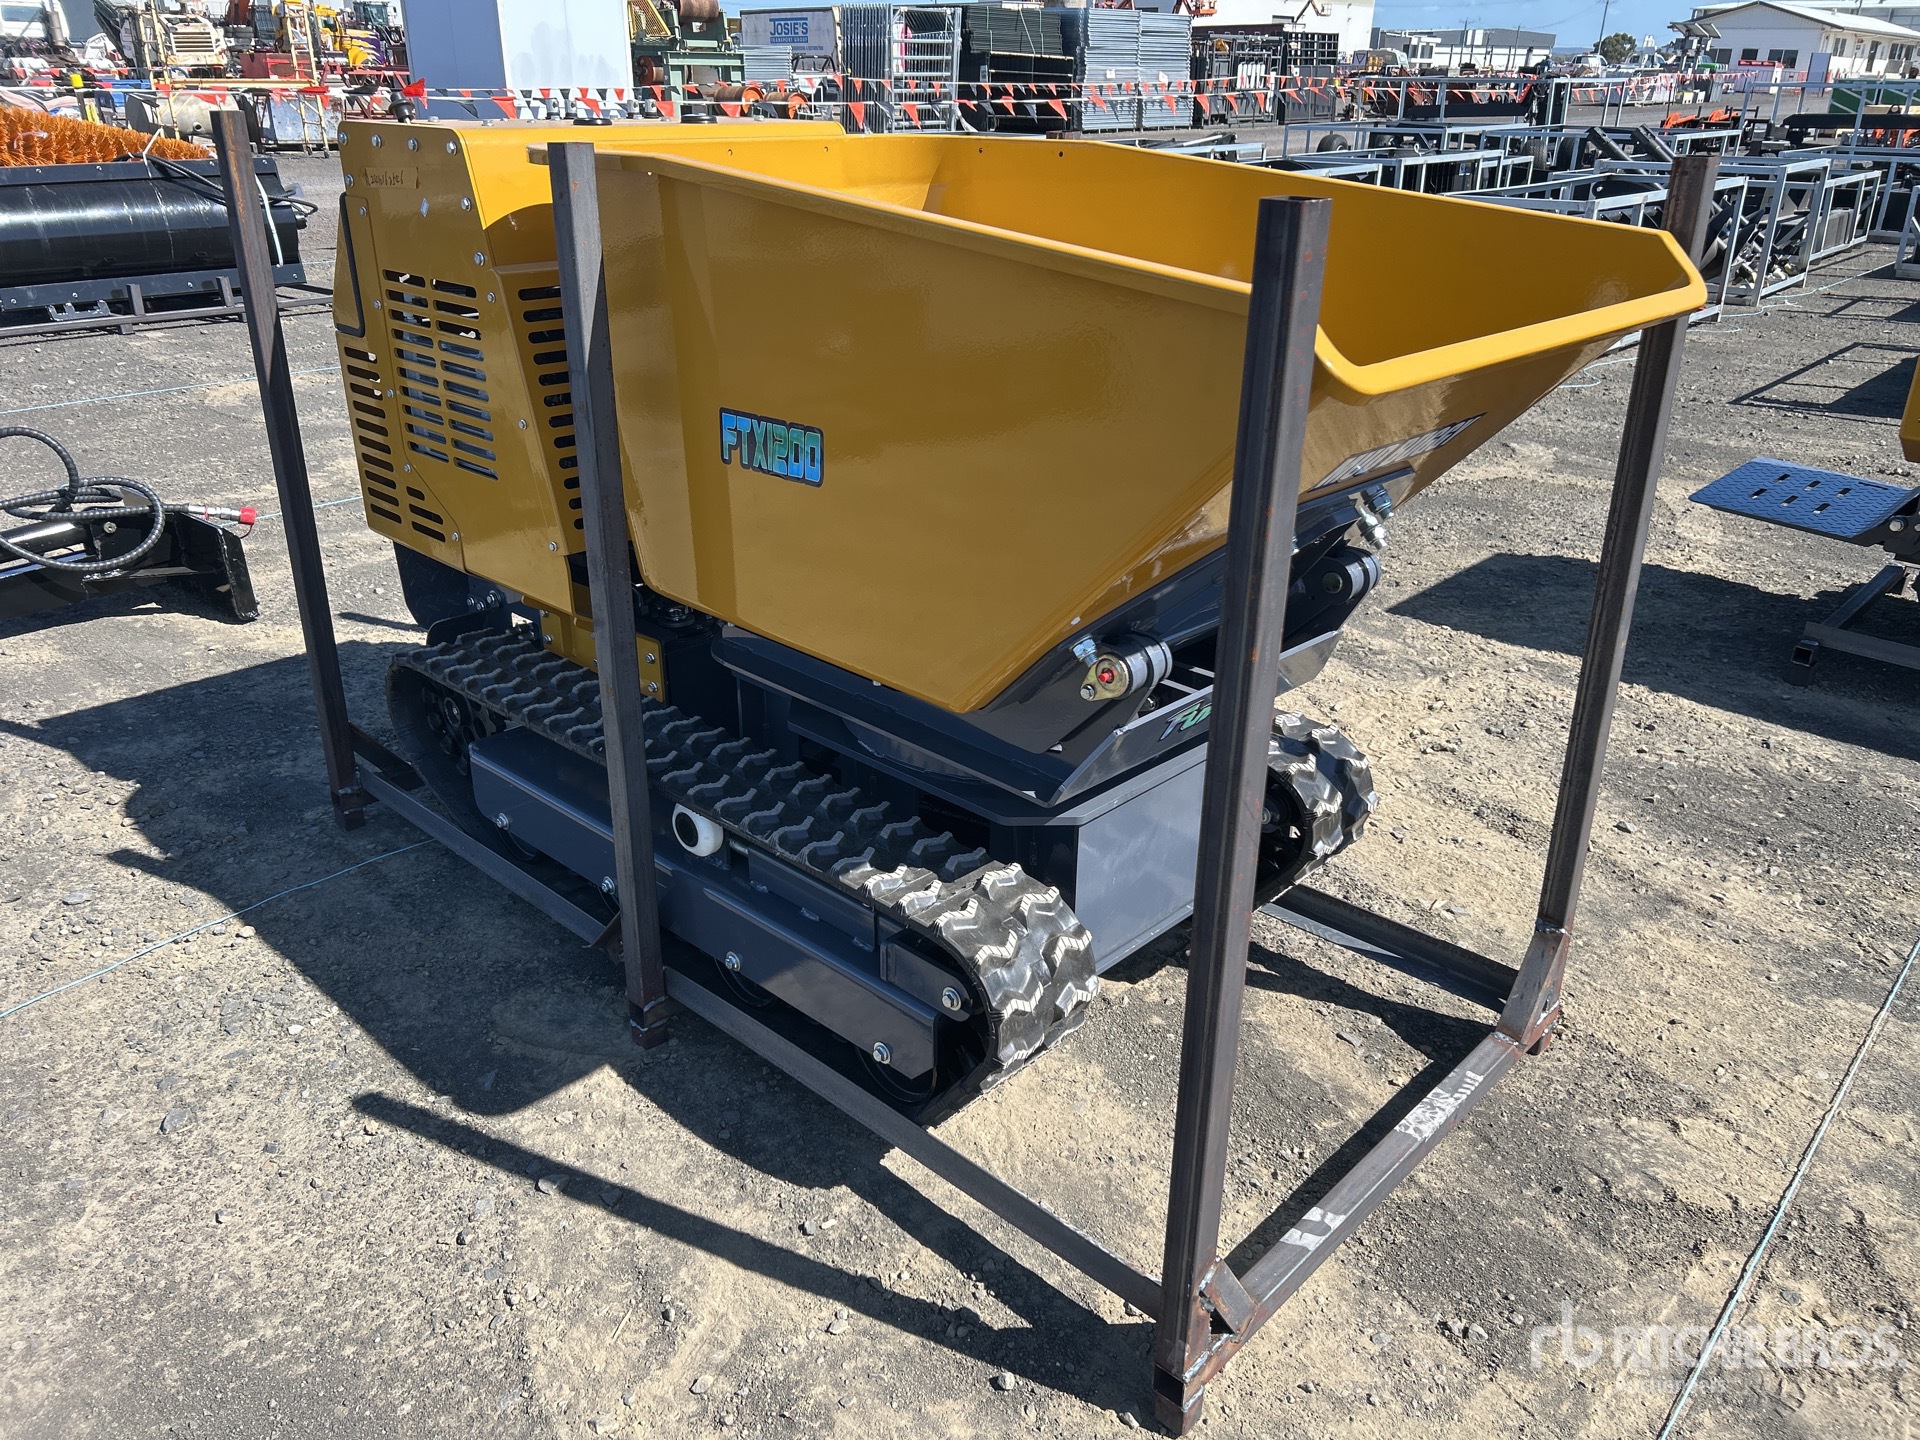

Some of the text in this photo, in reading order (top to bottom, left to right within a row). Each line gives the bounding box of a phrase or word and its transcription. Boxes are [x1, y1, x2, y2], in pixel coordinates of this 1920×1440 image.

[769, 17, 808, 36] JOSIE'S
[721, 411, 822, 484] FTX1200
[1310, 414, 1485, 490] MUD BUGGY
